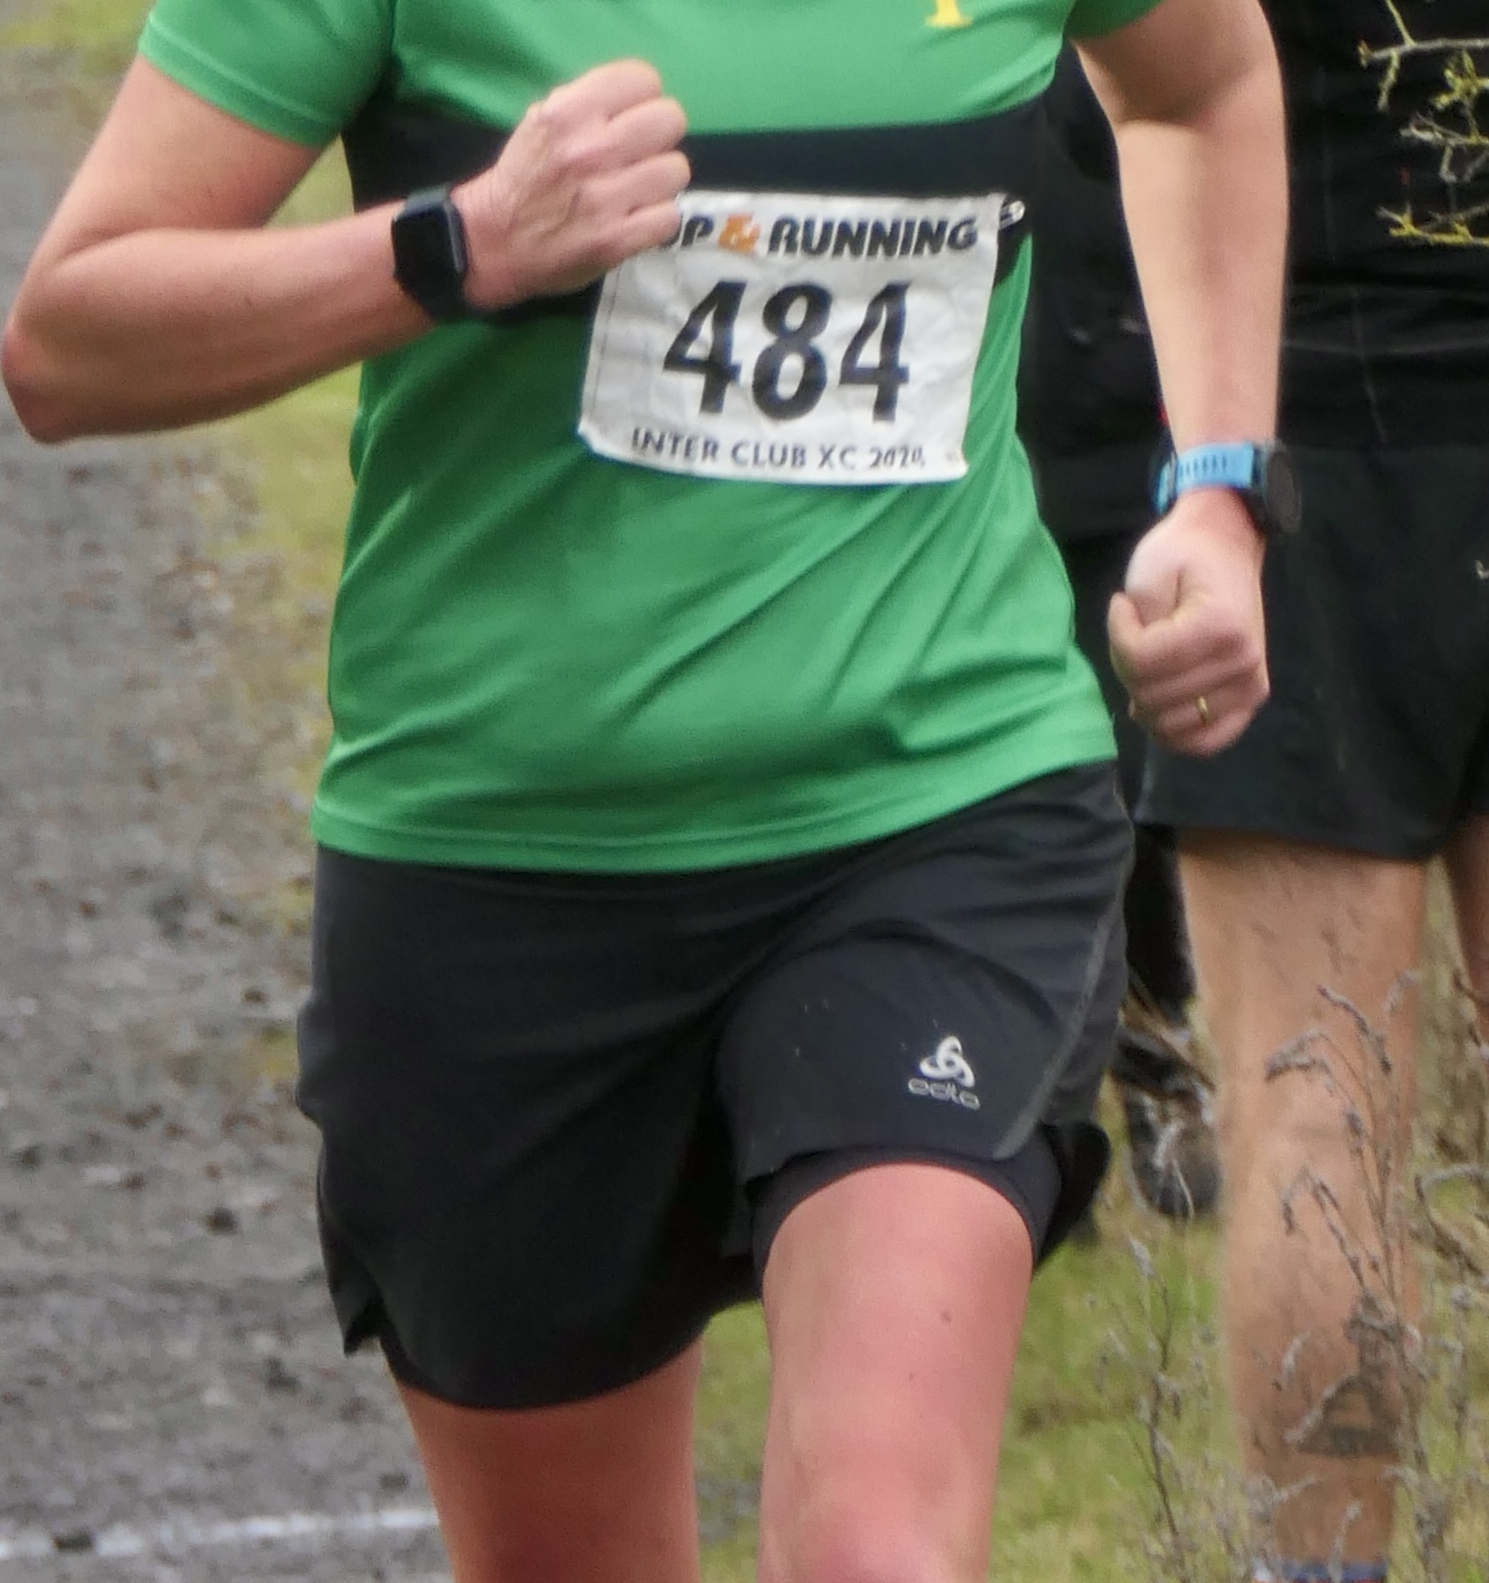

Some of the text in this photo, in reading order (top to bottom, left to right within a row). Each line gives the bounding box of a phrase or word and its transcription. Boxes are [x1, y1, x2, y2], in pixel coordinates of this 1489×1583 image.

[663, 213, 979, 257] P & RUNNING
[663, 281, 911, 423] 484
[631, 427, 721, 462] INTER
[731, 439, 808, 468] CLUB
[818, 444, 862, 471] XC
